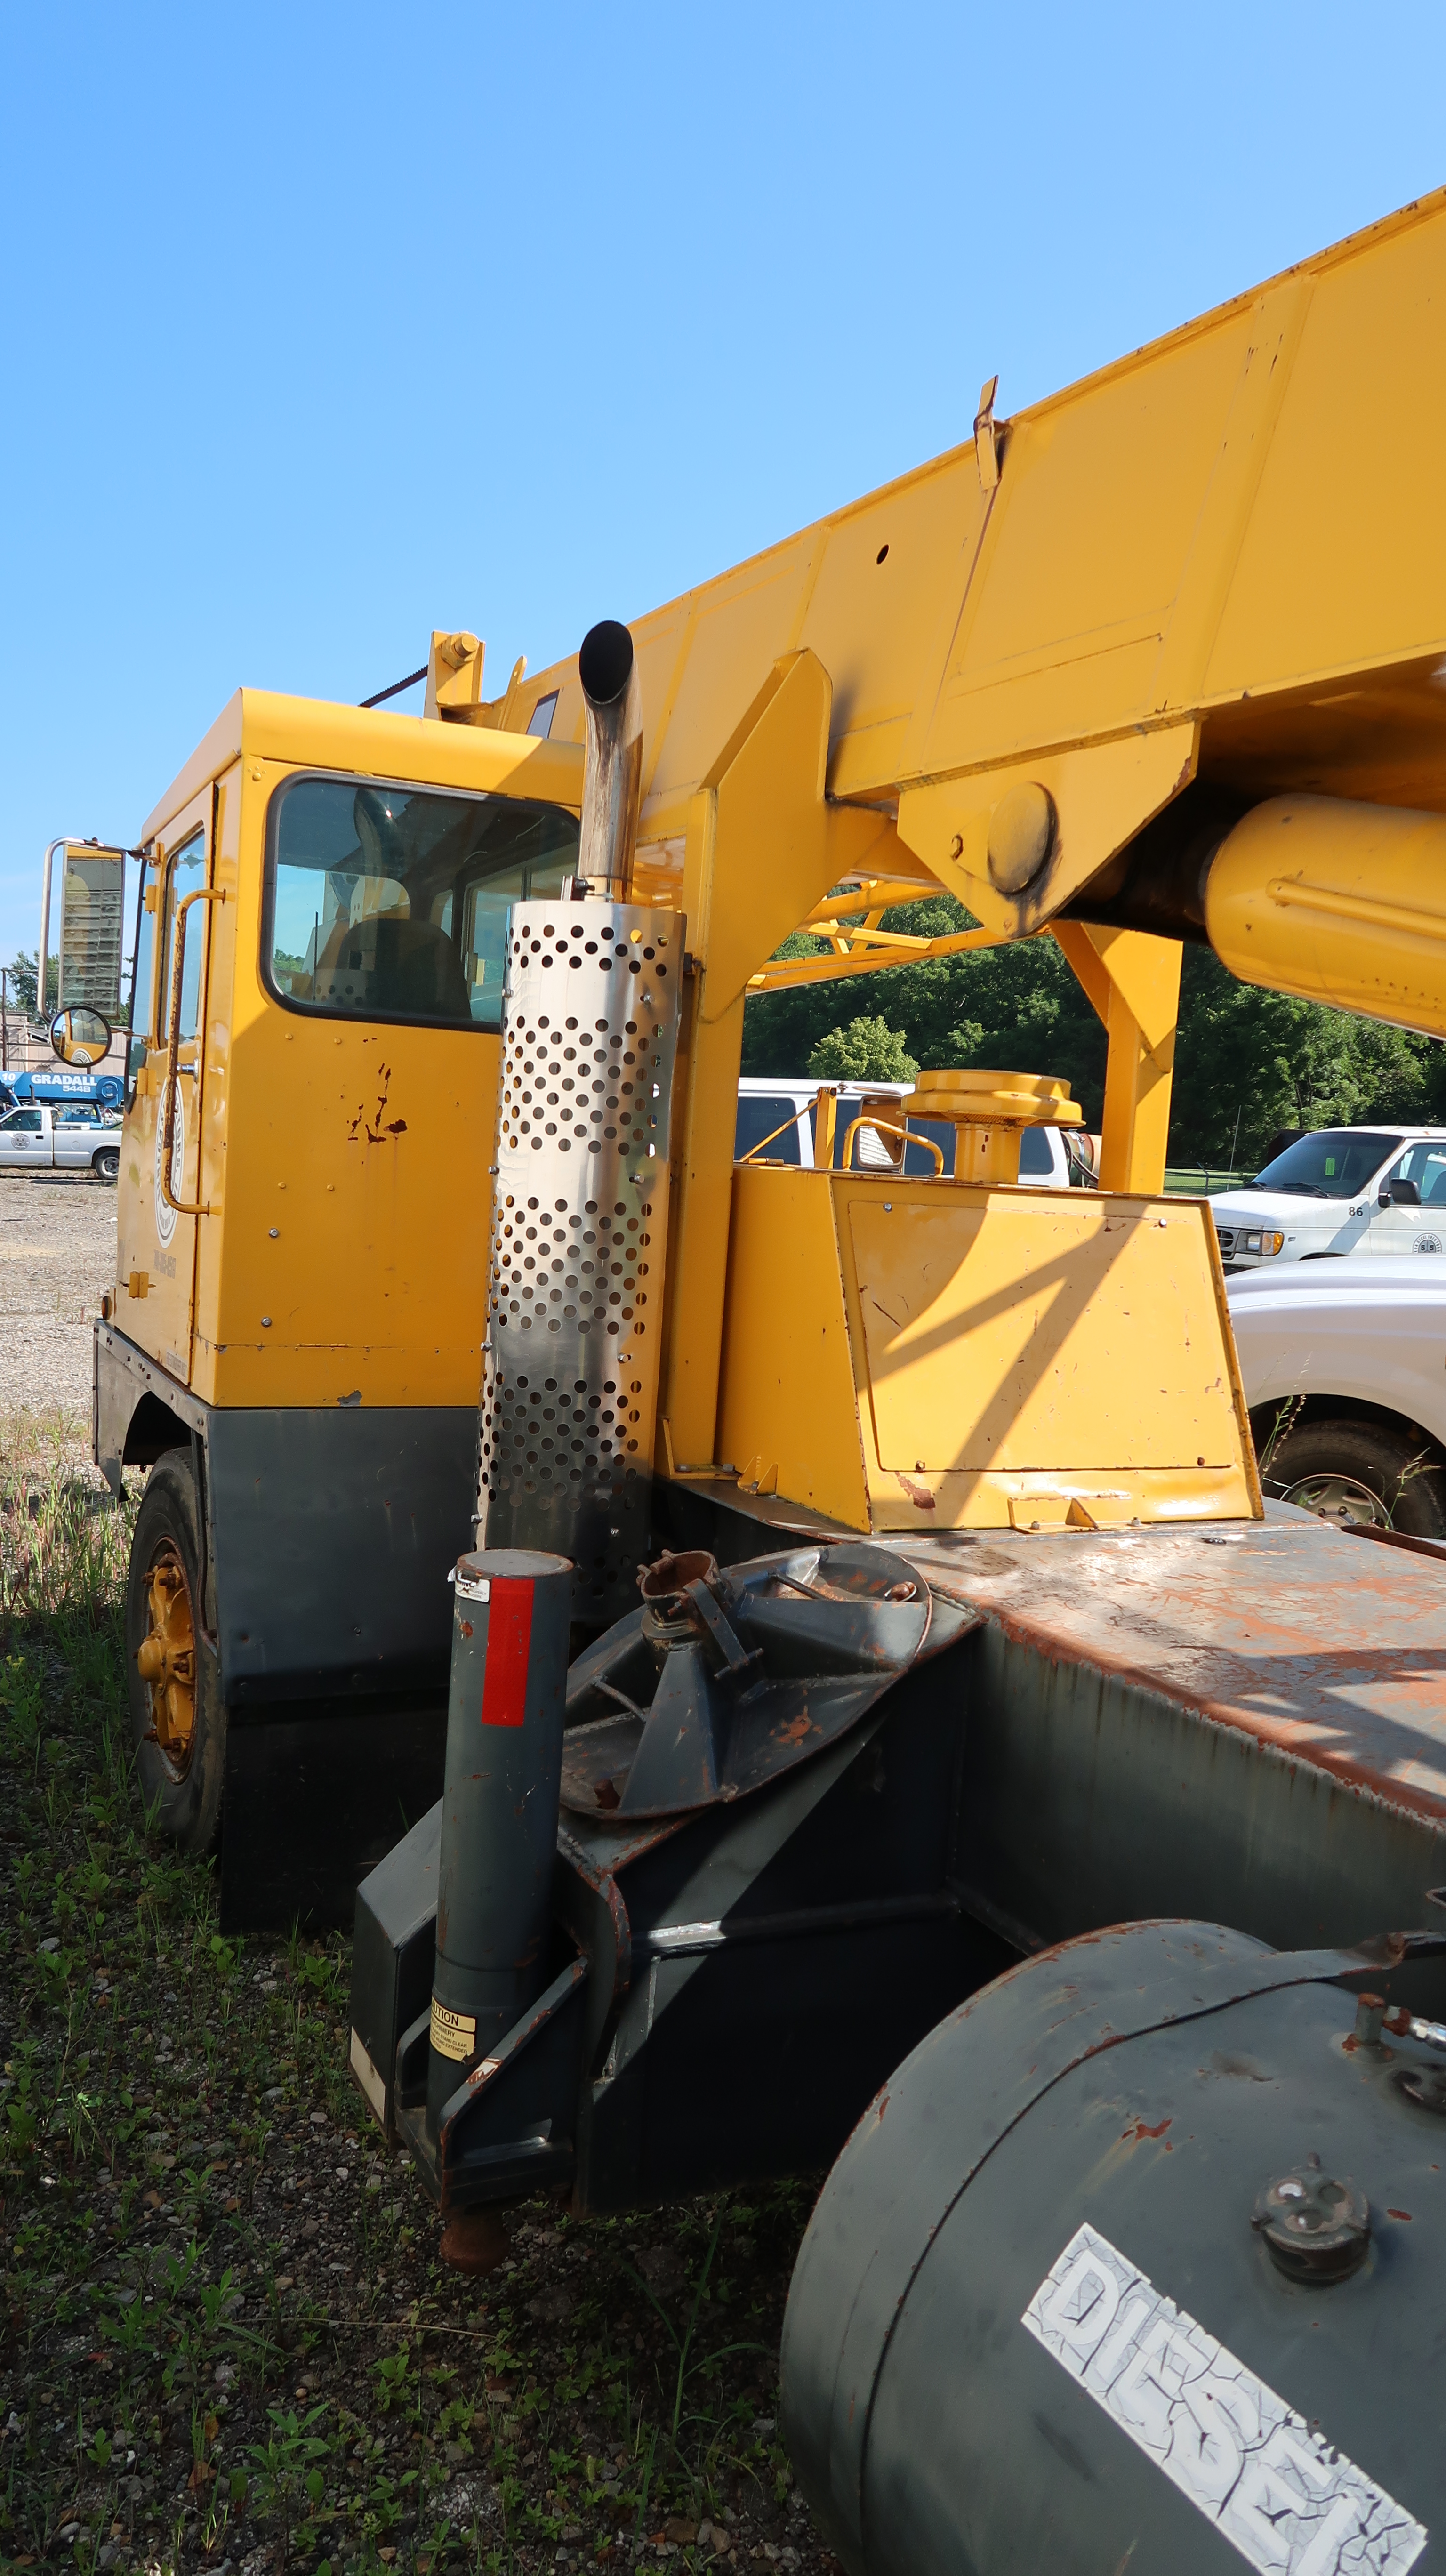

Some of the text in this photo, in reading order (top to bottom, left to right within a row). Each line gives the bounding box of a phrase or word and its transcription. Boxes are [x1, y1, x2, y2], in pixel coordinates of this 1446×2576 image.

[2, 1073, 16, 1081] 10
[31, 1074, 97, 1086] GRADALL
[1349, 1207, 1363, 1216] 86
[445, 2042, 467, 2054] EXTENDED
